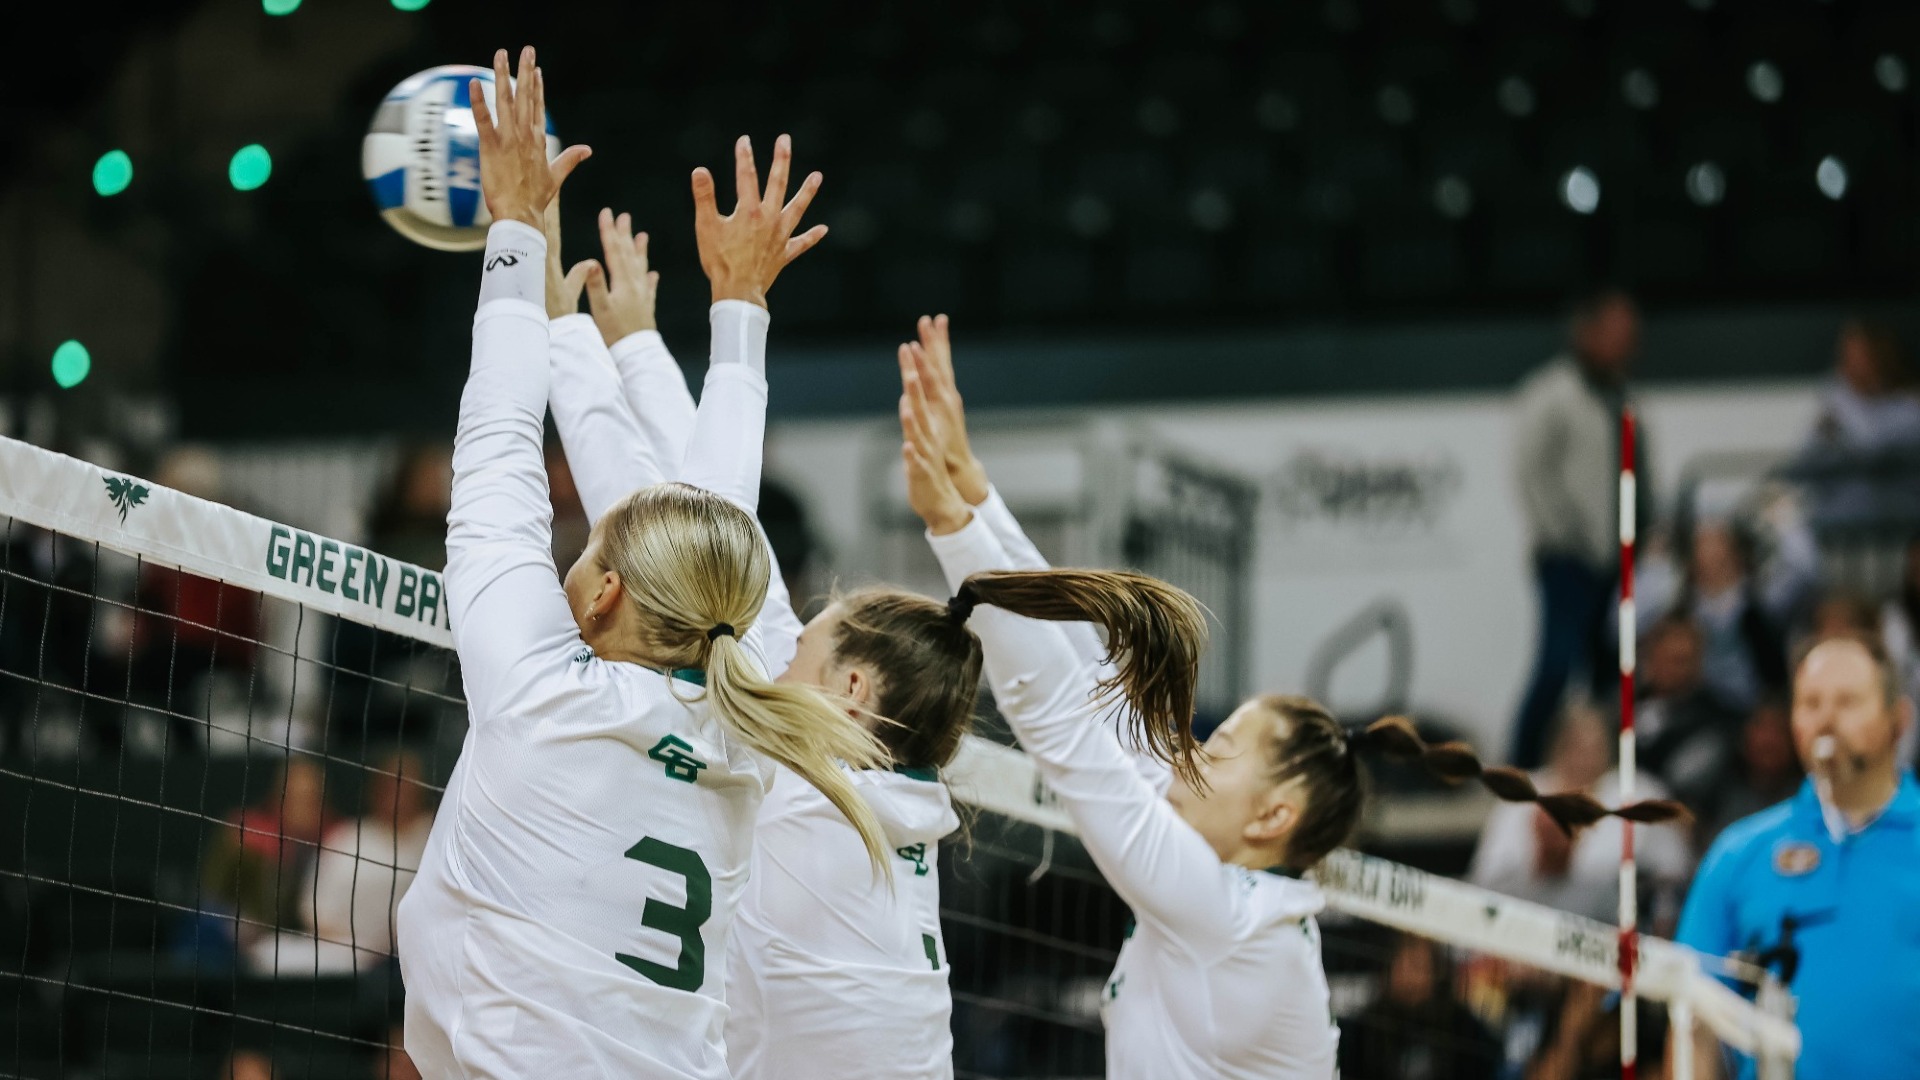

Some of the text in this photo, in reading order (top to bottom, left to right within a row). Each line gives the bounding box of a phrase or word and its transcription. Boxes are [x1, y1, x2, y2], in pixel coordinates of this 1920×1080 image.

[266, 524, 452, 632] GREEN BA
[647, 733, 708, 784] GB
[614, 835, 712, 993] 3
